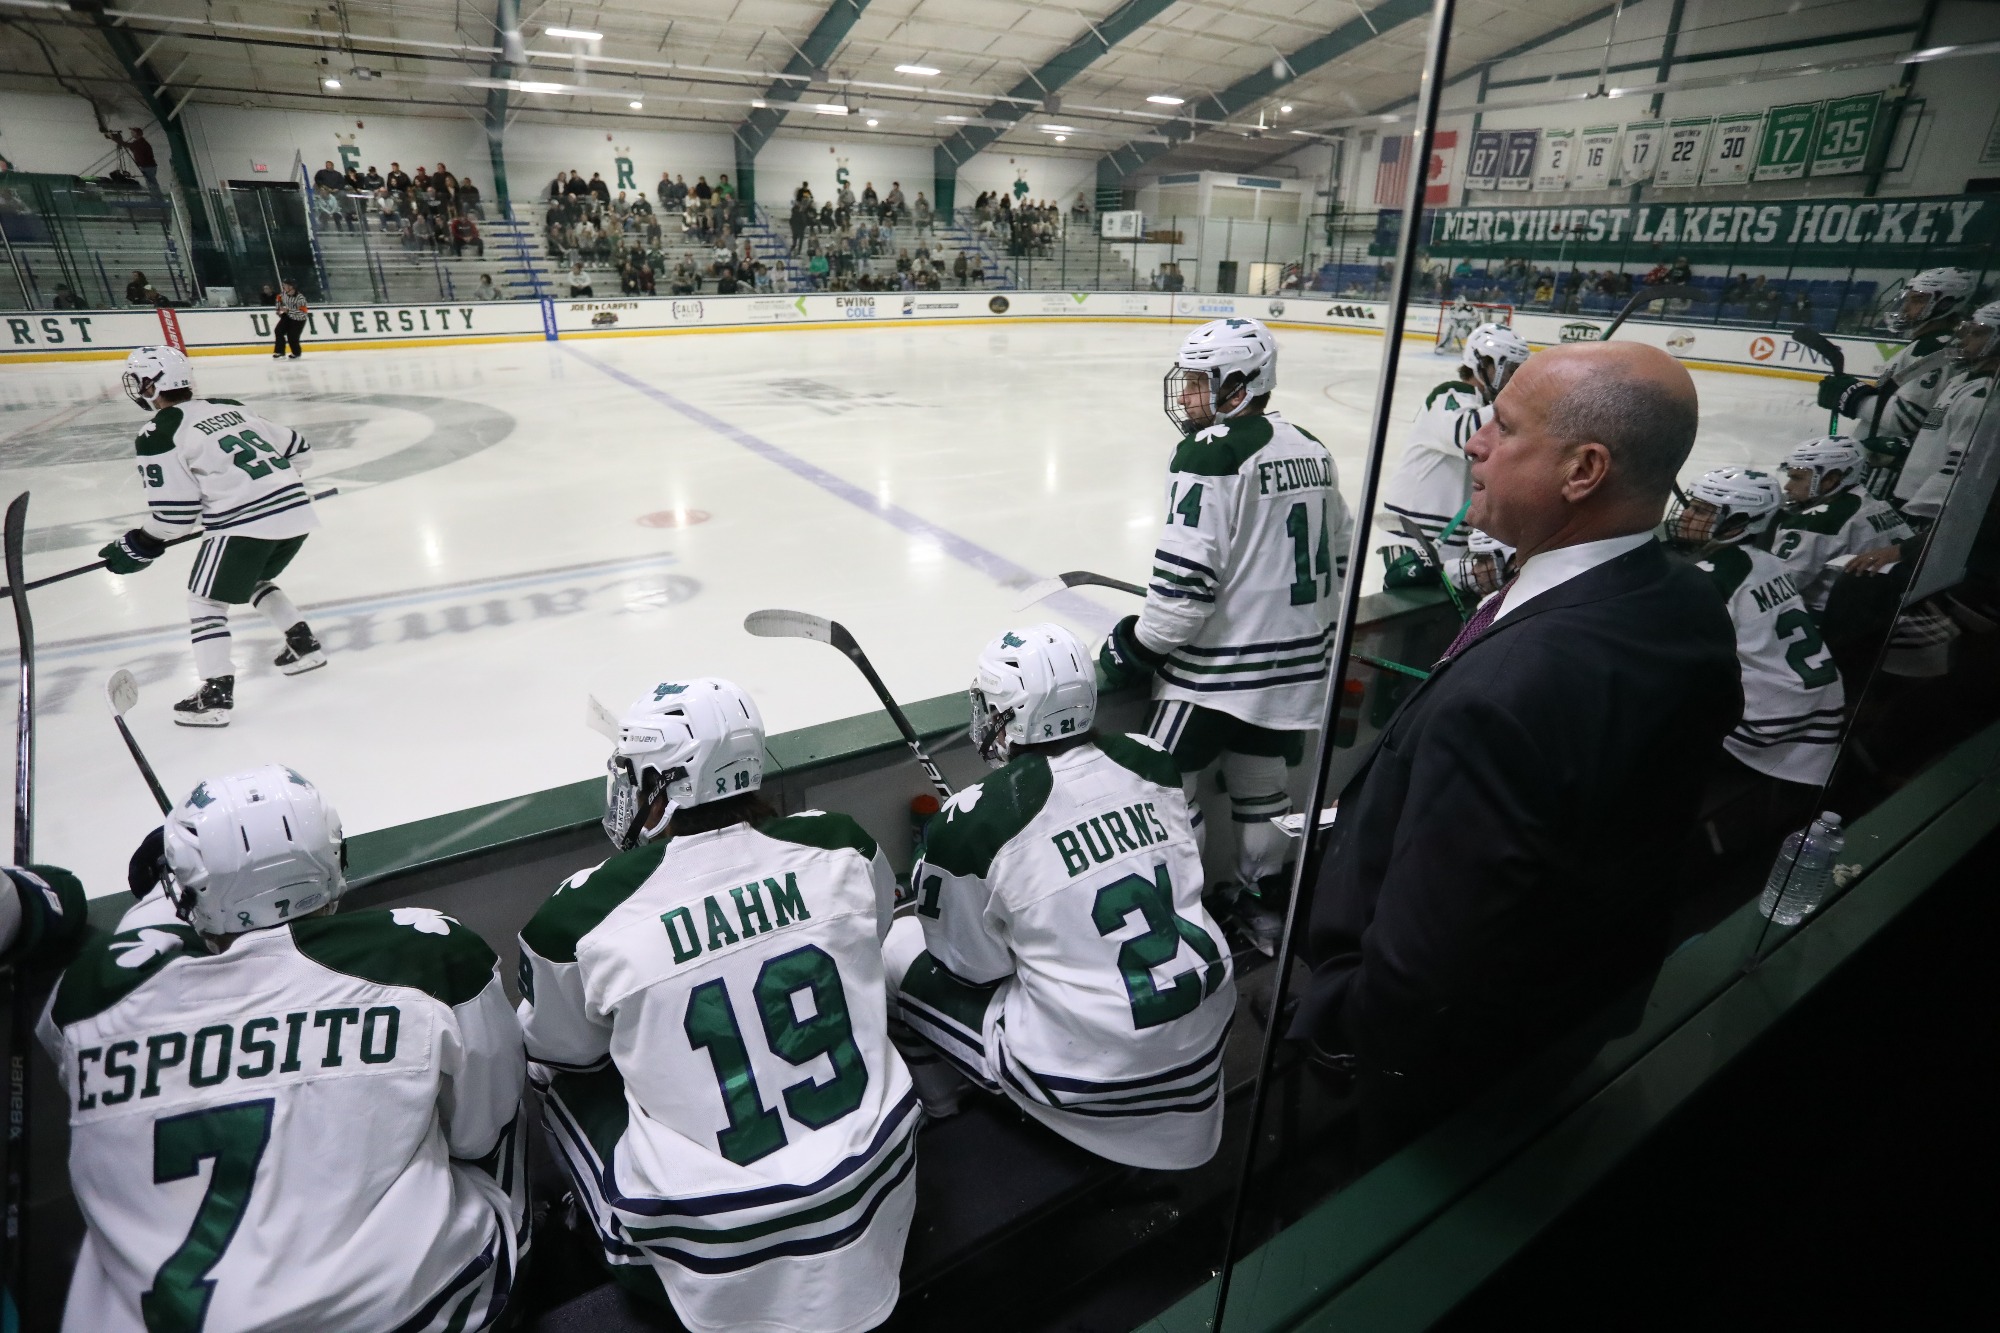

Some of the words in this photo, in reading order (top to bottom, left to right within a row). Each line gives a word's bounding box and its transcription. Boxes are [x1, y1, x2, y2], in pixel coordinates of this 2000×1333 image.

[1720, 137, 1745, 159] 30
[1771, 127, 1804, 162] 17
[1822, 117, 1868, 155] 35
[1471, 149, 1498, 176] 87
[1508, 149, 1531, 176] 17
[1551, 150, 1563, 169] 2
[1587, 148, 1604, 167] 16
[1632, 144, 1649, 163] 17
[1671, 141, 1695, 161] 22
[614, 157, 637, 190] R
[836, 168, 849, 187] S
[1441, 208, 1630, 242] MERCYHURST
[1633, 206, 1783, 243] LAKERS
[1787, 201, 1985, 243] HOCKEY
[836, 297, 875, 307] EWING
[846, 308, 875, 317] COLE
[6, 317, 93, 344] RST
[250, 308, 474, 337] UIVERSITY
[1561, 327, 1600, 340] PLYLER
[194, 411, 246, 436] BISSON
[218, 429, 291, 481] 29
[1166, 480, 1204, 529] 14
[119, 536, 154, 563] BAUE
[1060, 717, 1076, 735] 21
[734, 770, 750, 791] 19
[1052, 801, 1169, 878] BURNS
[274, 898, 291, 919] 7
[914, 873, 944, 921] 1
[660, 871, 812, 965] DAHM
[1091, 863, 1226, 1031] 21
[517, 948, 535, 1008] 9
[77, 1005, 401, 1112] ESPOSITO
[683, 943, 870, 1168] 19
[141, 1097, 276, 1333] 7
